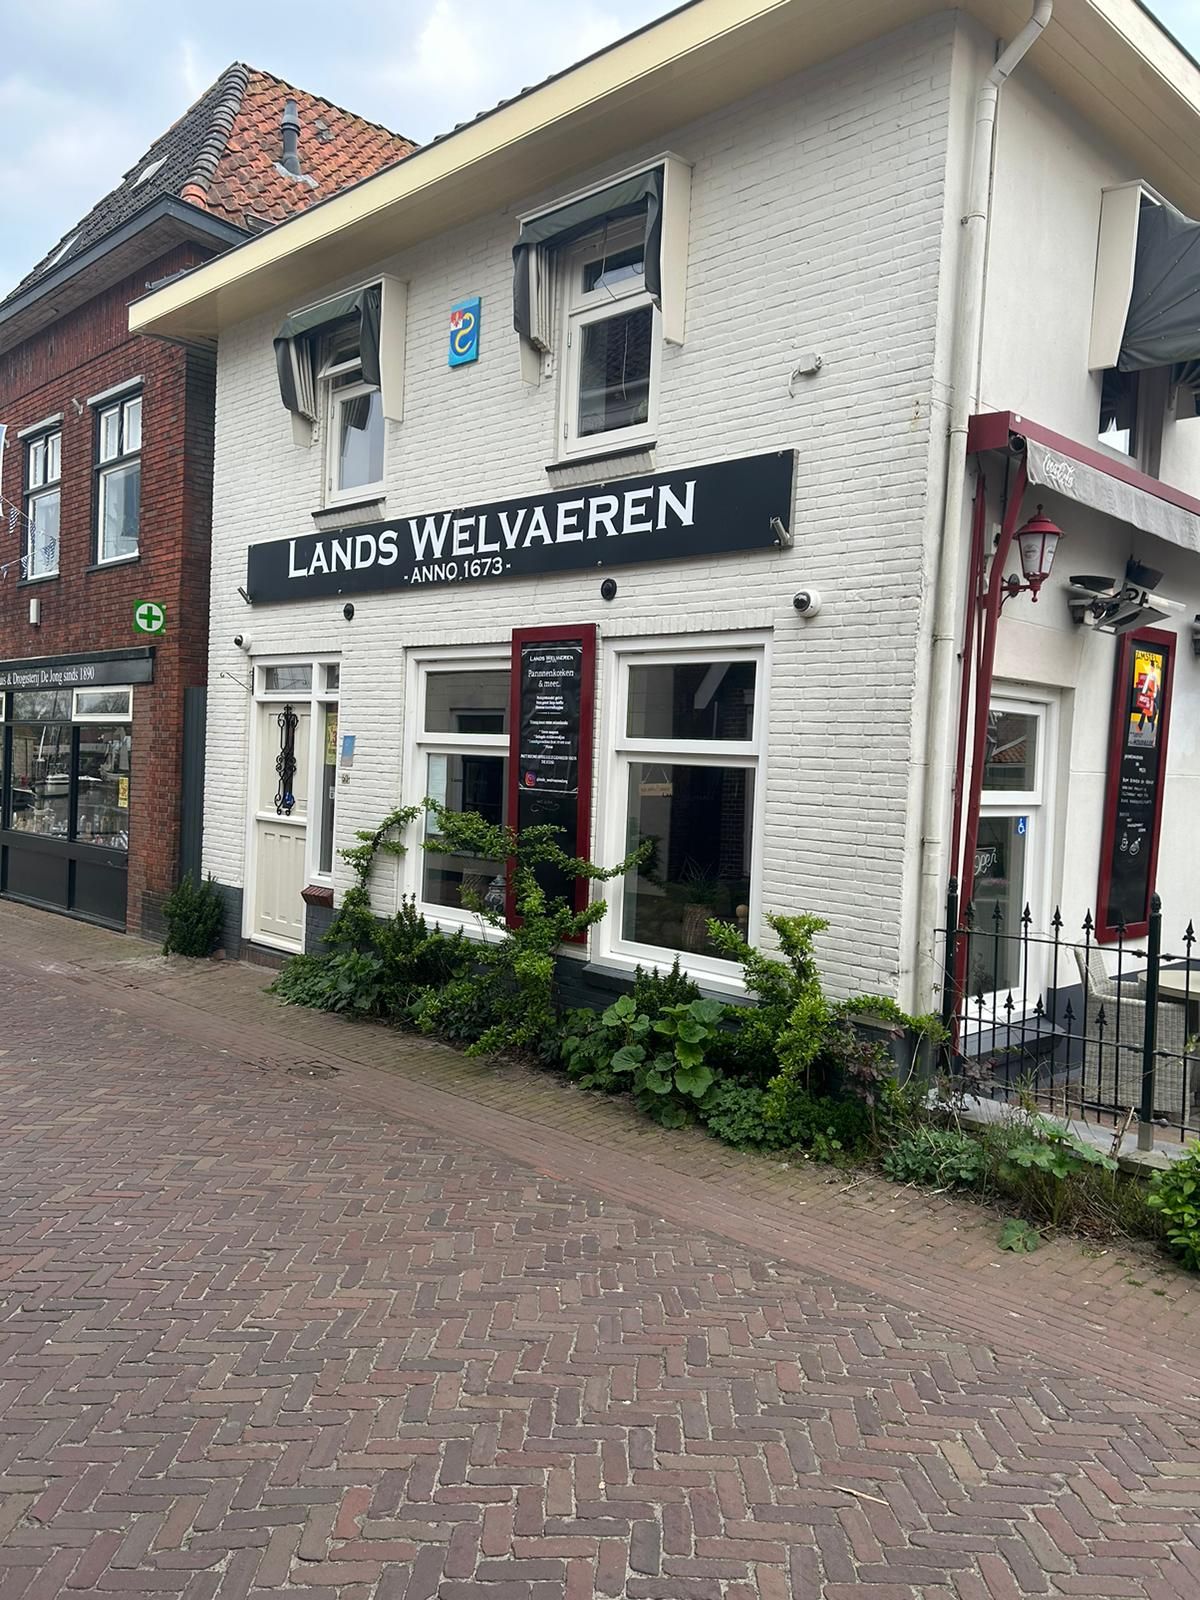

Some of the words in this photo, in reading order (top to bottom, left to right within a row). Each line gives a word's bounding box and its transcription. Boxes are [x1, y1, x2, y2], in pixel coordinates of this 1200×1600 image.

[288, 529, 400, 579] LANDS
[408, 480, 697, 561] WELVAEREN
[7, 673, 12, 685] &
[12, 670, 40, 688] Drogisterij
[40, 671, 49, 682] De
[49, 669, 63, 685] Jong
[63, 667, 79, 681] sinds
[80, 666, 95, 680] 1890
